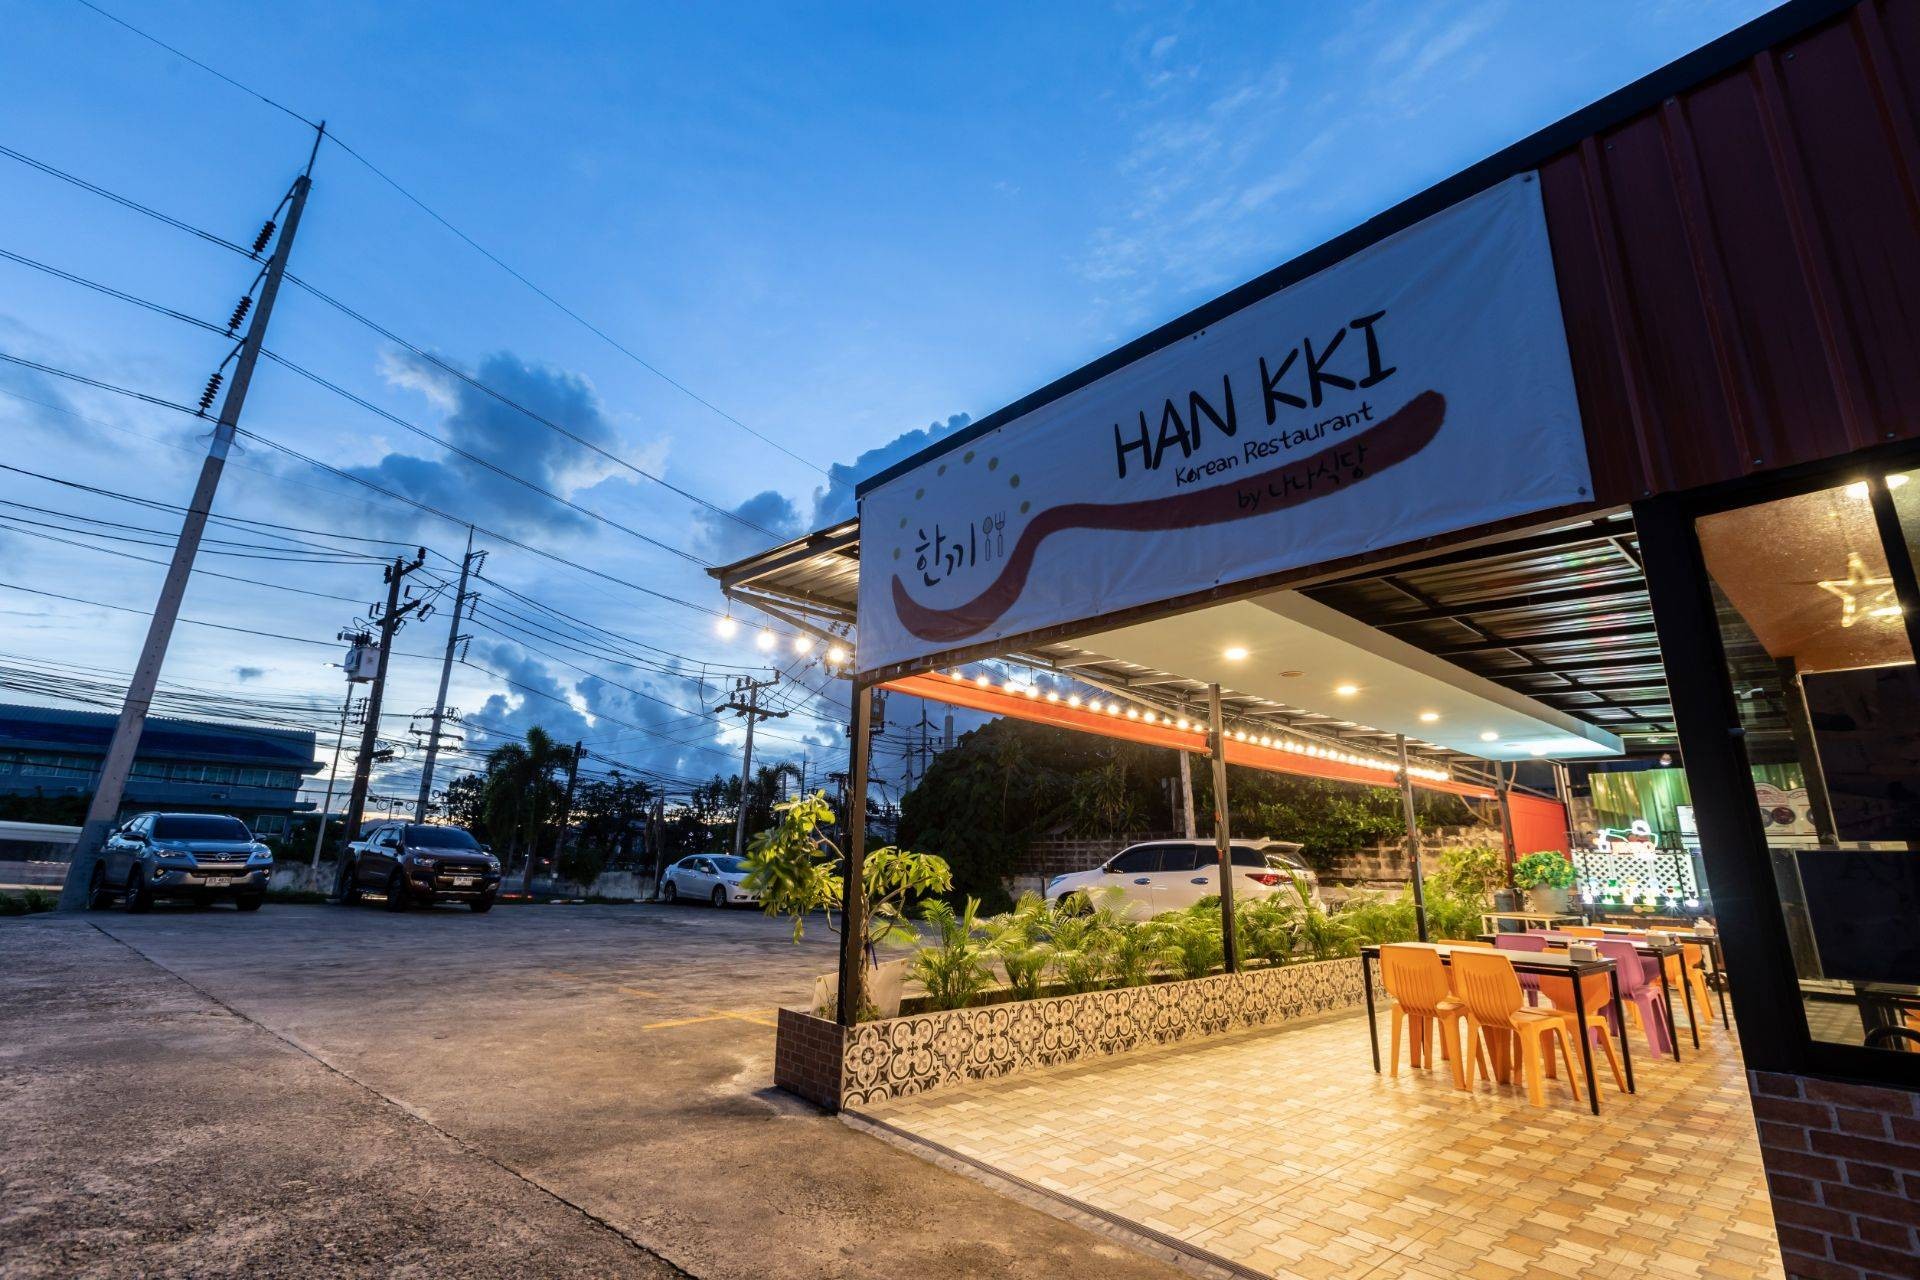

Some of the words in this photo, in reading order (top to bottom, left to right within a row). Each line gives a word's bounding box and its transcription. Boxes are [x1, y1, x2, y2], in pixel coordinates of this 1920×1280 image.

[1114, 374, 1237, 479] HAN
[1259, 309, 1397, 425] KKI
[1175, 456, 1239, 487] Korean
[1243, 401, 1375, 464] Restaurant
[1237, 490, 1262, 511] by
[1268, 443, 1368, 497] 나나식당
[915, 522, 976, 587] 한끼
